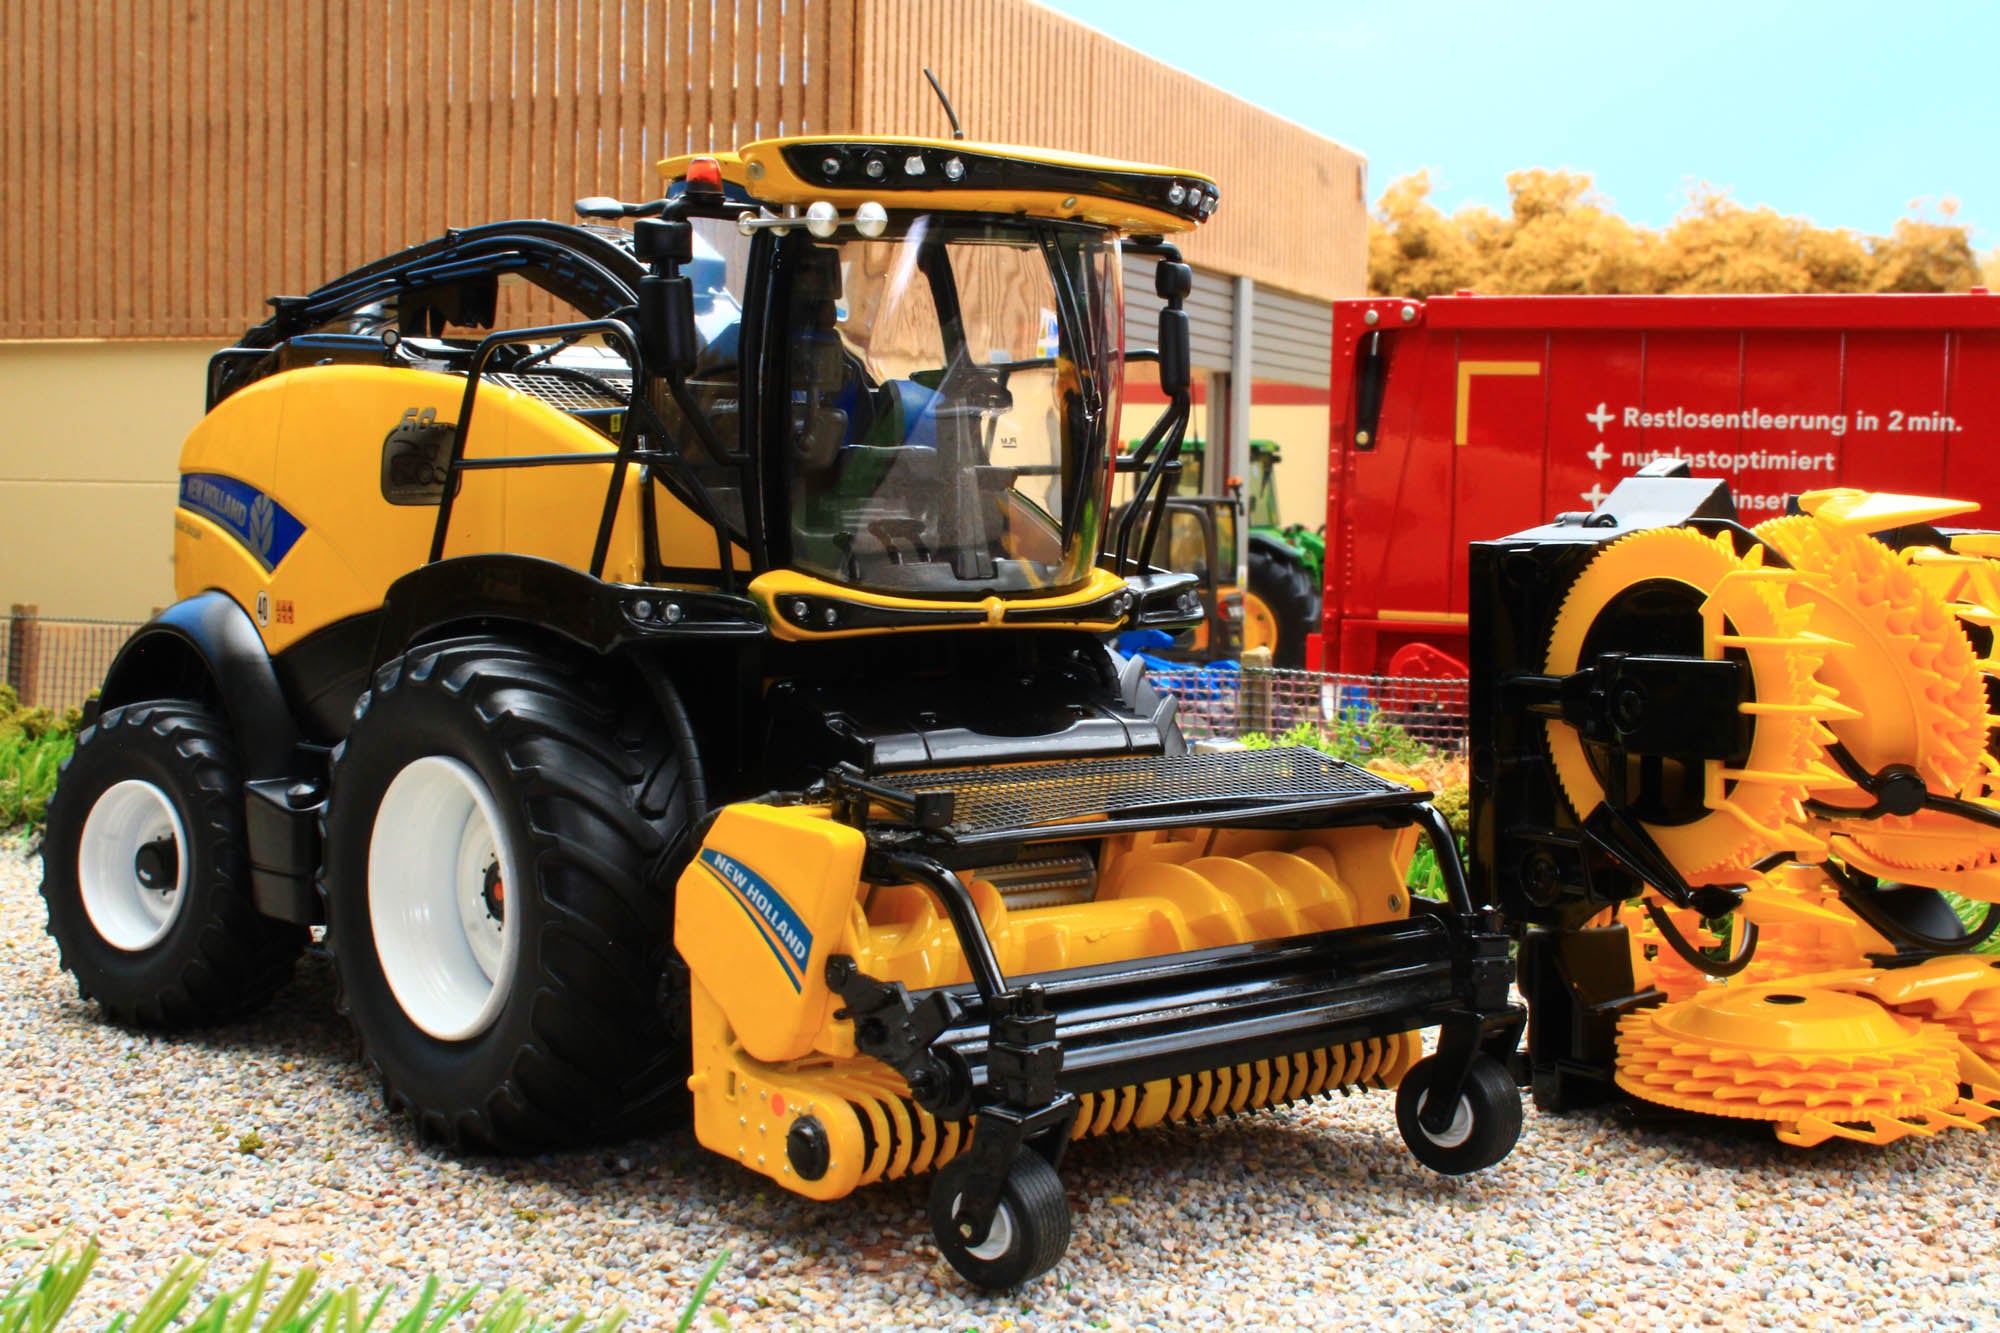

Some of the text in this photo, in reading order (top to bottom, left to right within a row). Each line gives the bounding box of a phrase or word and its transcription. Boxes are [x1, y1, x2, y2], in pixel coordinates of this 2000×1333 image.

[1623, 407, 1963, 436] Restlosentleerung in 2 min.
[203, 482, 247, 528] HOLLAND
[713, 853, 806, 960] NEW HOLLAND
